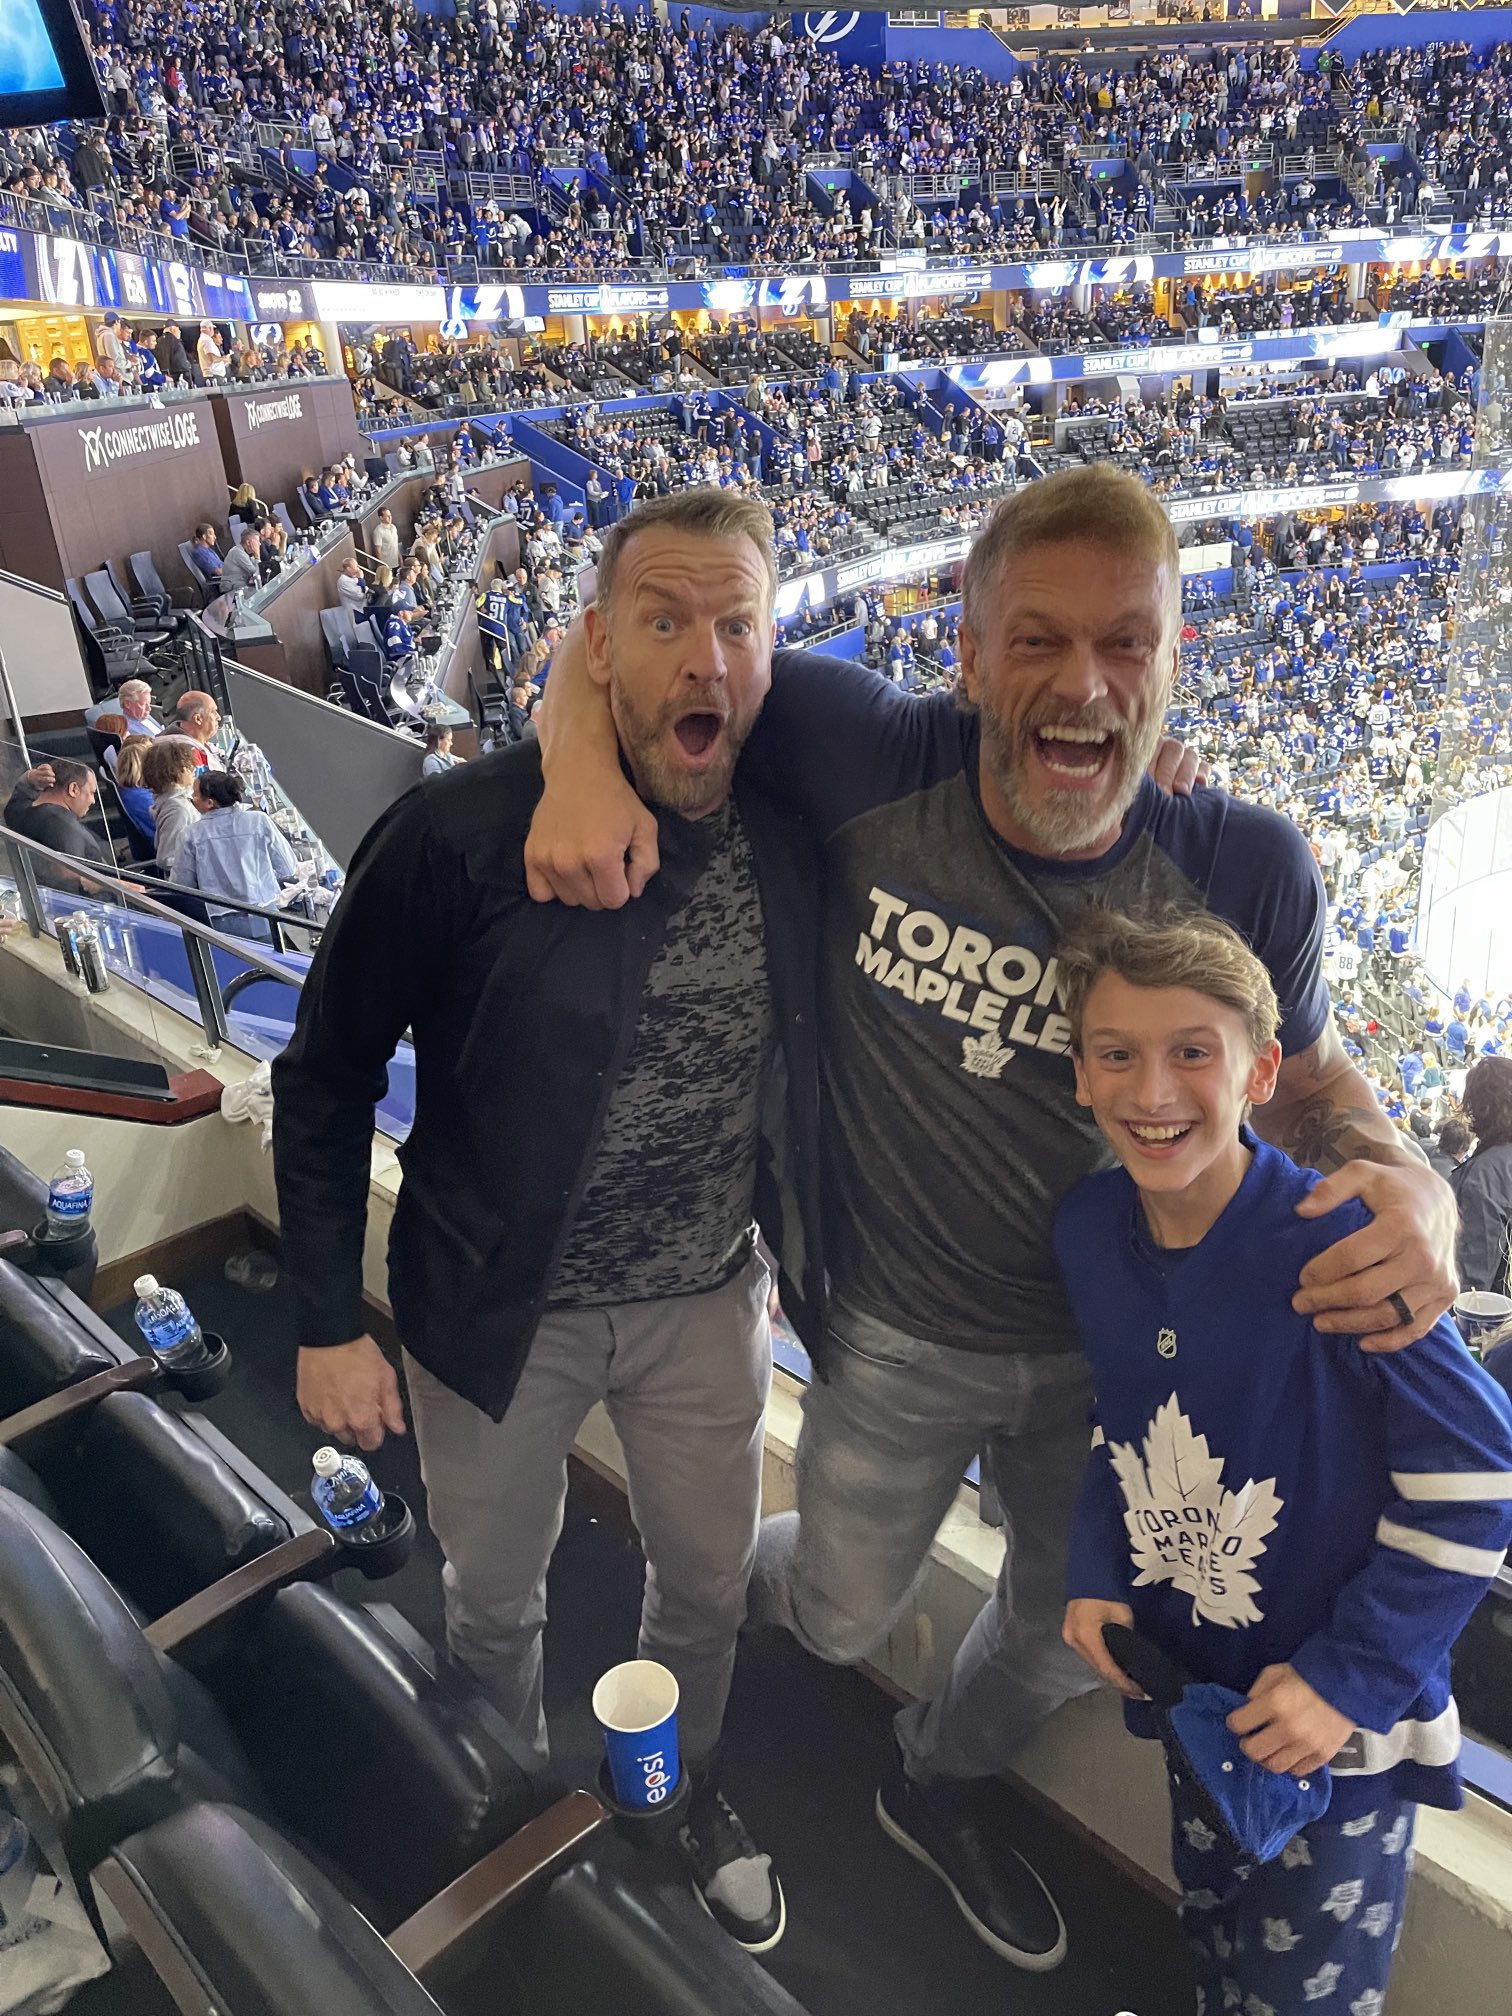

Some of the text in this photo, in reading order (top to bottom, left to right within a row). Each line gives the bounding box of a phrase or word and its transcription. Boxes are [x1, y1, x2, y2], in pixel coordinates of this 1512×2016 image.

[1184, 256, 1229, 271] STANLEY
[1228, 255, 1250, 268] CUP
[849, 280, 884, 294] STANLEY
[885, 279, 904, 293] CUP
[548, 293, 584, 309] STANLEY
[584, 292, 600, 308] CUP
[1083, 356, 1125, 372] STANLEY
[1125, 354, 1149, 369] CUP
[104, 411, 200, 460] CONNECTWISE LOGE
[1170, 501, 1217, 520] STANLEY
[1217, 499, 1241, 513] CUP
[489, 602, 505, 620] 91
[1374, 713, 1384, 722] 91
[1339, 956, 1354, 970] 88
[854, 931, 1074, 1057] MAPLE LE
[51, 1198, 89, 1211] AQUAFINA
